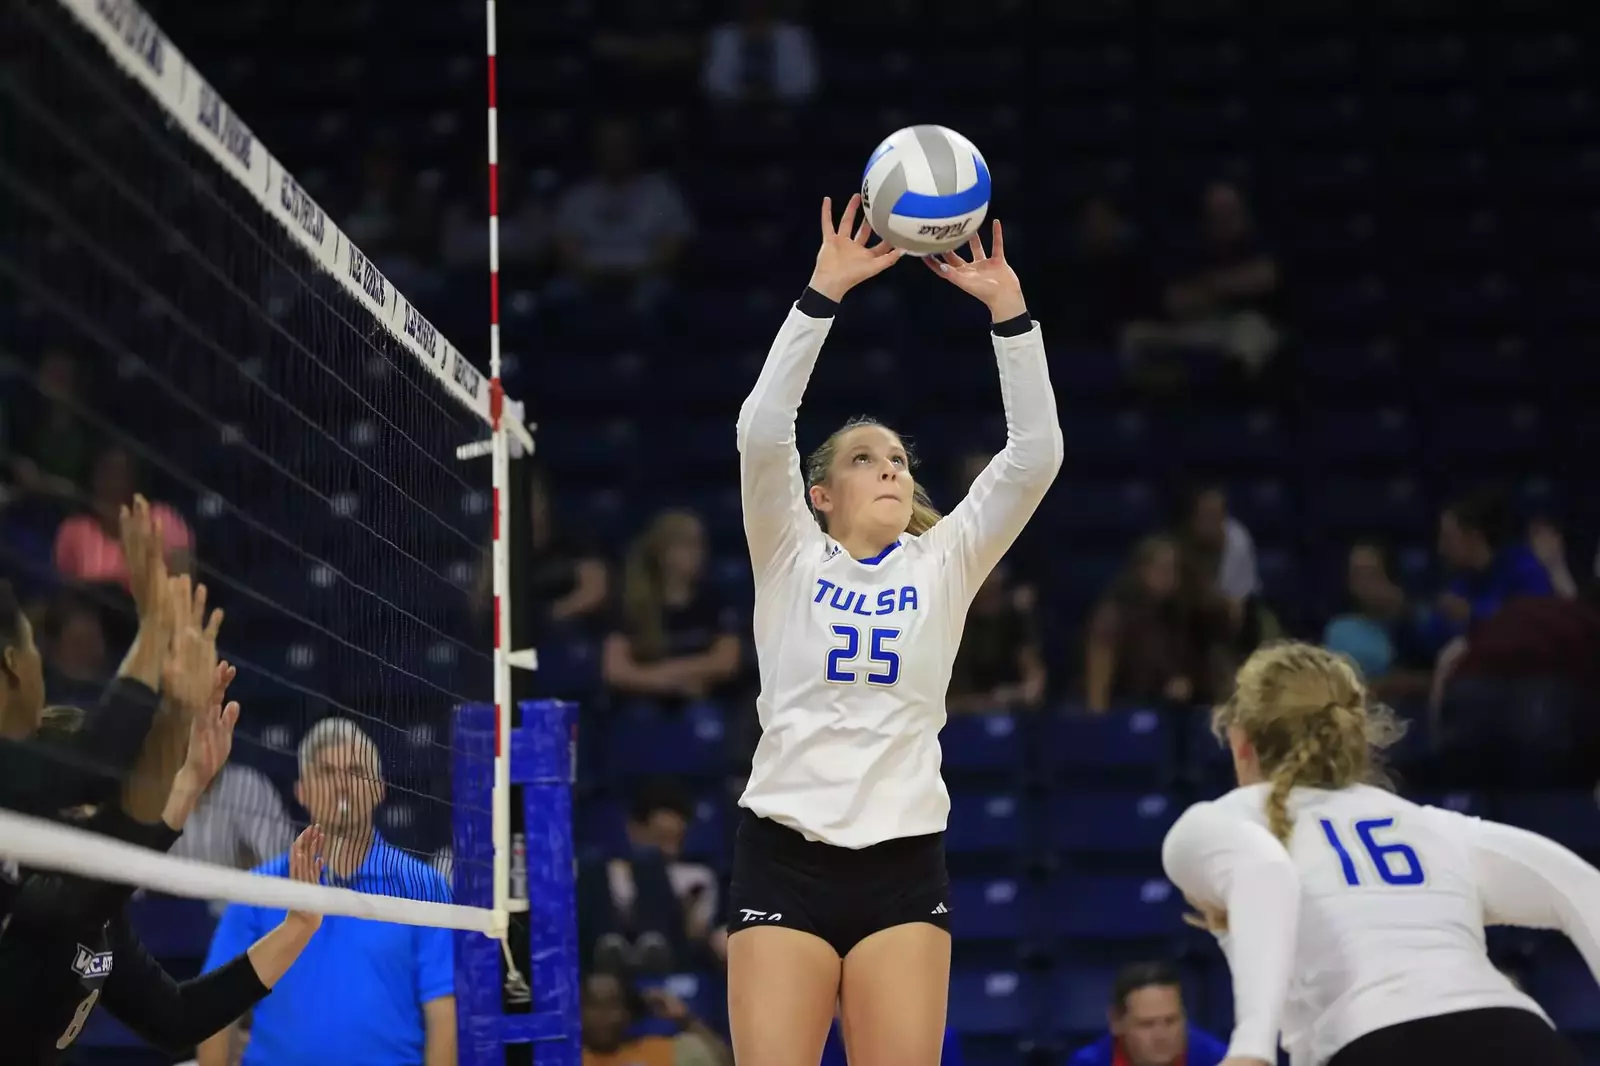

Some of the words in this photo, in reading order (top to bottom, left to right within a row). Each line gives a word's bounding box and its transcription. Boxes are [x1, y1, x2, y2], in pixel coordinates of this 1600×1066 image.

[813, 578, 918, 616] TULSA
[825, 623, 902, 687] 25
[1318, 816, 1426, 887] 16
[56, 988, 99, 1050] 8
